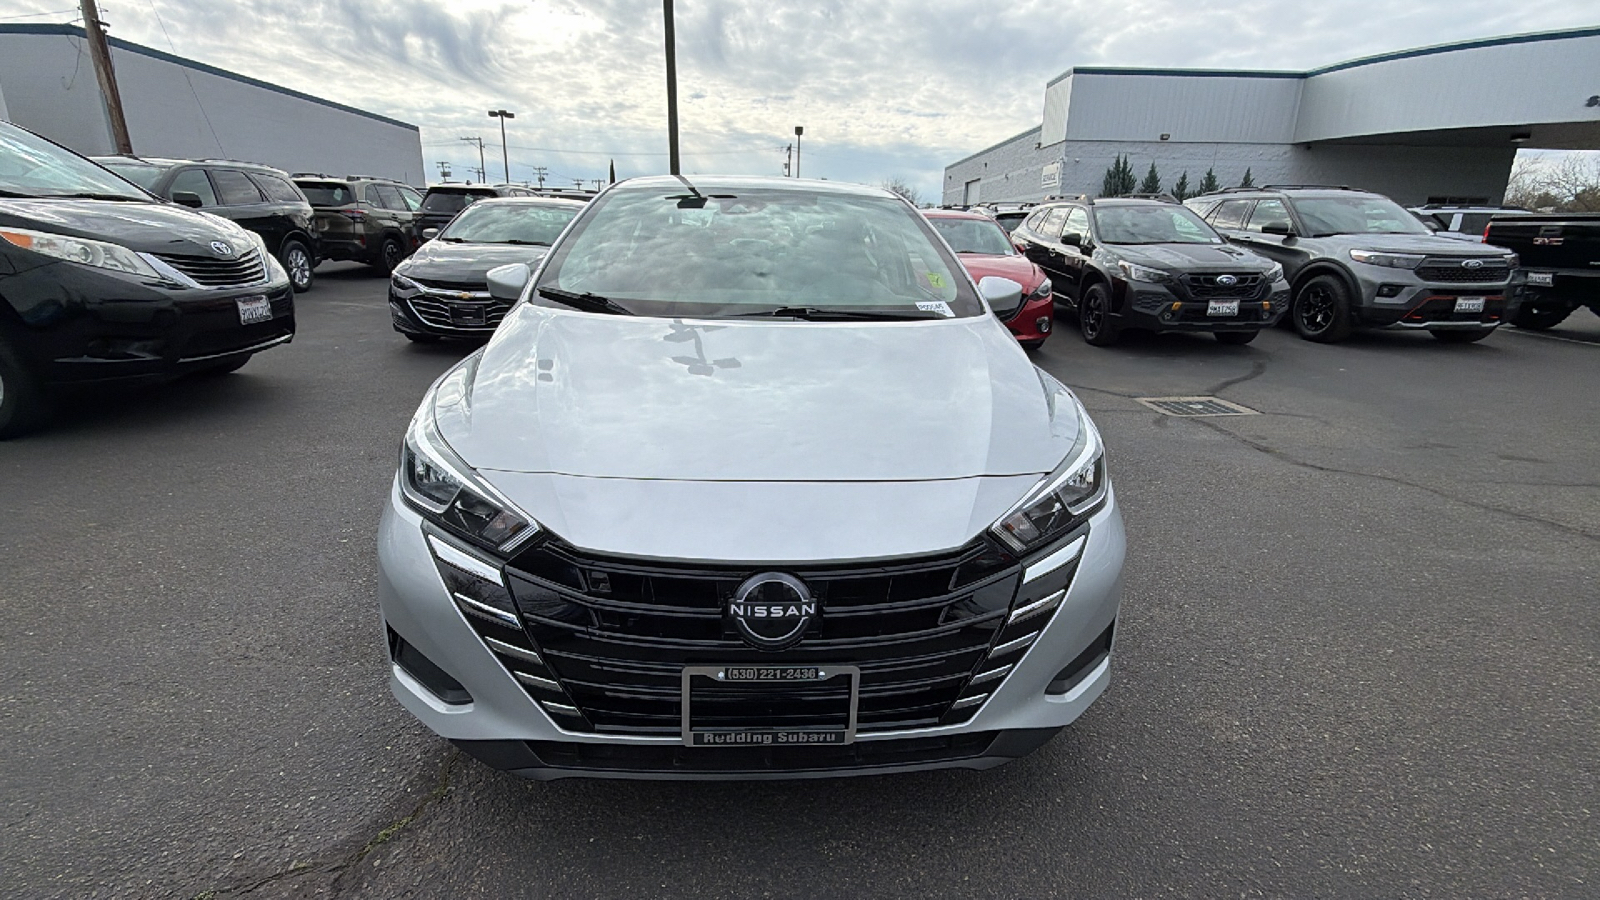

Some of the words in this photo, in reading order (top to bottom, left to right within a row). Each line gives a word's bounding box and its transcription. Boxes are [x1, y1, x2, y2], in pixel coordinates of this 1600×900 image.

[730, 603, 816, 618] NISSAN
[727, 668, 758, 680] (530)
[759, 668, 816, 680] 221-2436
[703, 732, 773, 744] Redding
[777, 731, 836, 743] Subaru
